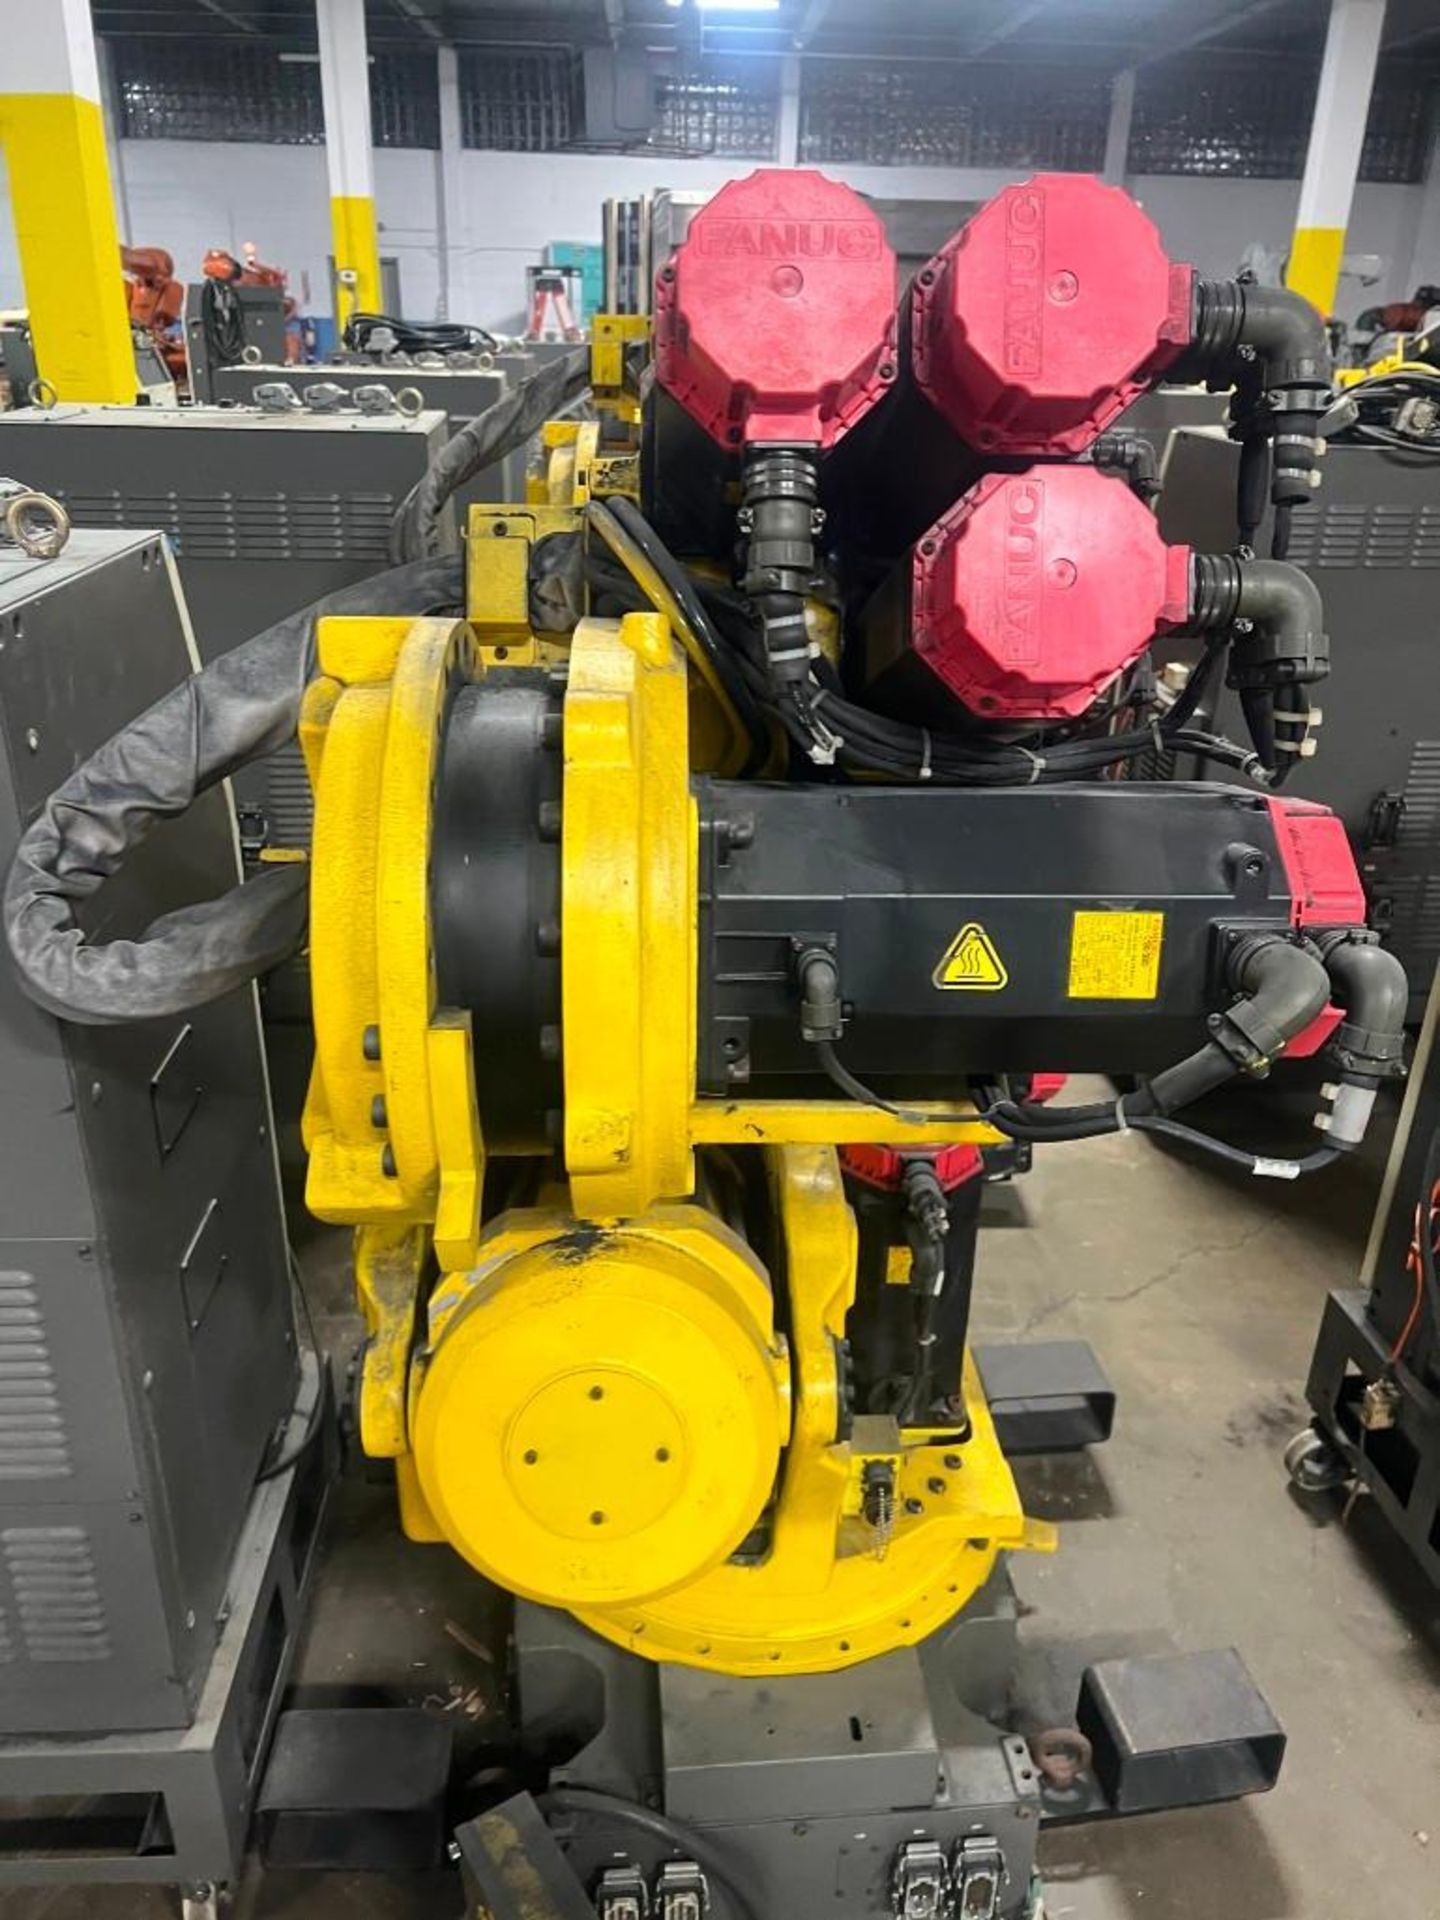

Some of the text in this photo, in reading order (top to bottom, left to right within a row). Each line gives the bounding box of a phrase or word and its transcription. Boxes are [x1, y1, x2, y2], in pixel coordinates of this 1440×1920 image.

[704, 222, 879, 257] FANUC
[1006, 194, 1040, 368] FANUC
[1005, 483, 1040, 659] FANUC
